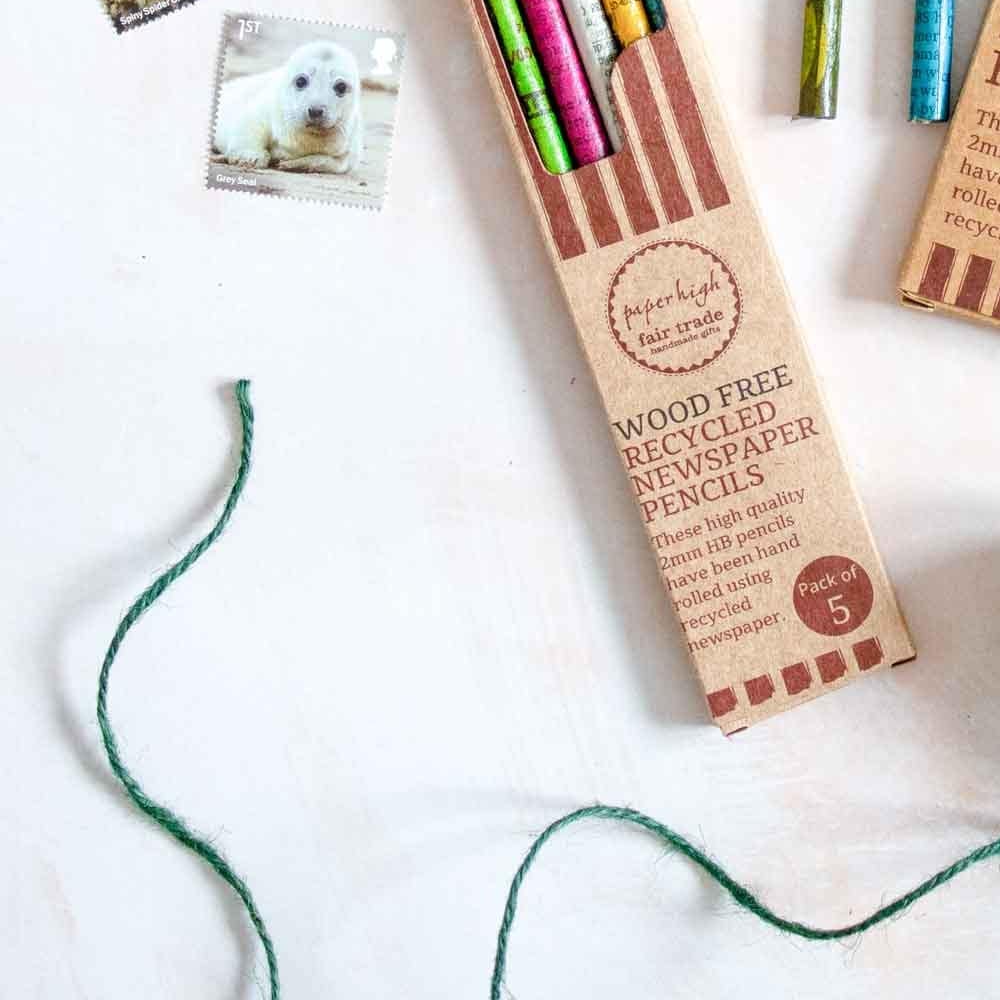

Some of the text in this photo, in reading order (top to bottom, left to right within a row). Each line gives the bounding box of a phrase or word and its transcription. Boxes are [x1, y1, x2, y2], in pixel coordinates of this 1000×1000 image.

[119, 10, 143, 25] Spiny
[143, 0, 171, 16] Spider
[238, 19, 262, 40] 1ST
[216, 173, 257, 187] Grey Seal
[624, 269, 721, 331] paper high
[638, 309, 724, 348] fair trade
[650, 326, 721, 355] handmade gifts
[612, 364, 793, 441] WOOD FREE
[621, 400, 777, 470] RECYCLED
[630, 416, 819, 497] NEWSPAPER
[639, 464, 765, 524] PENCILS
[651, 488, 807, 549] These high quality
[660, 514, 795, 571] 2mm HB pencils
[666, 533, 801, 591] have been hand
[673, 569, 773, 612] rolled using
[798, 564, 860, 598] Pack of
[680, 596, 753, 632] recycled
[826, 594, 851, 625] 5
[687, 610, 787, 653] newspaper.
